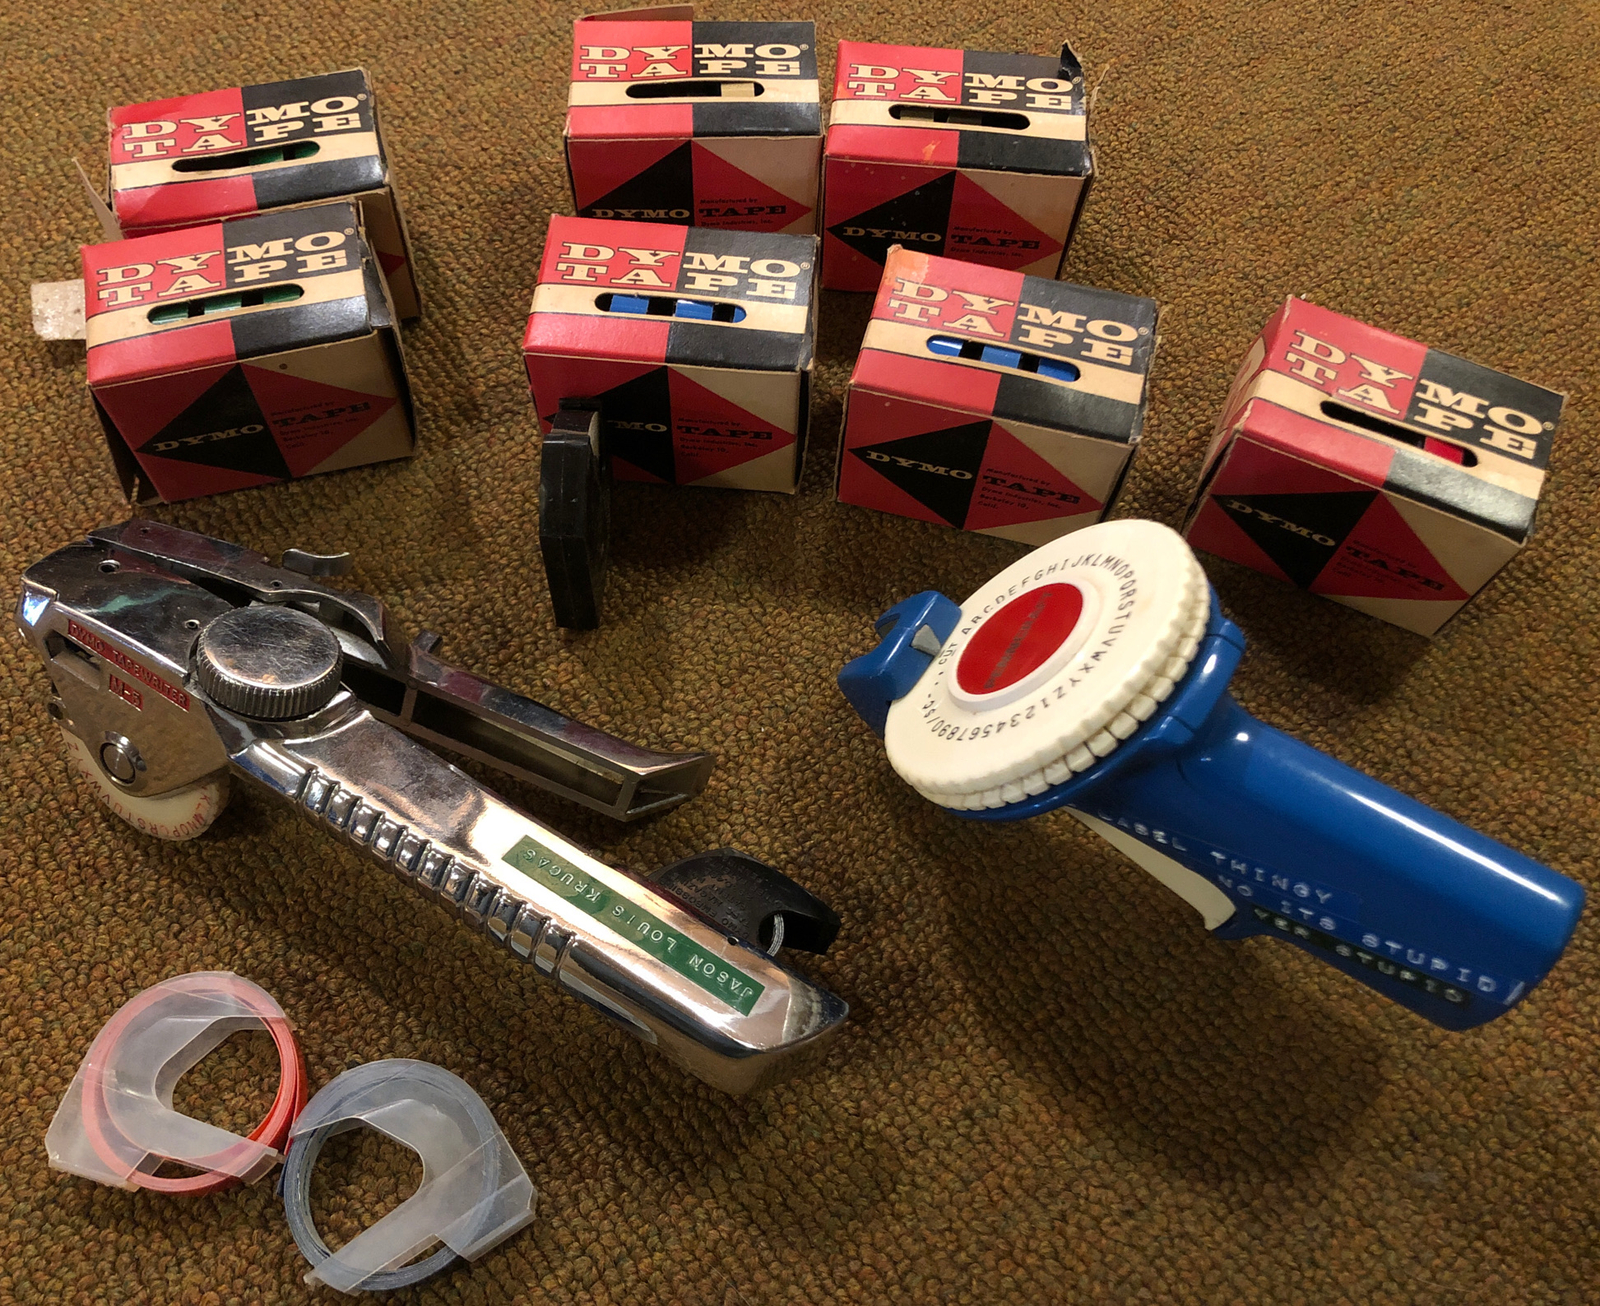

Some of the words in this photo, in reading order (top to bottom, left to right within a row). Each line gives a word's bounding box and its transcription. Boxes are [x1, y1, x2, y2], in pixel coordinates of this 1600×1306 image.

[579, 60, 800, 78] TAPE
[580, 44, 800, 61] DYMO
[848, 82, 1071, 110] TAPE
[850, 64, 1073, 92] DYMO
[122, 96, 359, 139] DYMO
[123, 113, 361, 157] TAPE
[592, 208, 690, 219] DYMO
[699, 205, 787, 217] TAPE
[97, 231, 346, 286] DYMO
[560, 241, 800, 278] DYMO
[843, 226, 941, 242] DYMO
[951, 234, 1040, 249] TAPE
[98, 250, 347, 307] TAPE
[555, 262, 797, 300] TAPE
[888, 299, 1133, 366] TAPE
[894, 278, 1138, 343] DYMO
[1284, 352, 1537, 460] TAPE
[1290, 330, 1543, 436] DYMO
[154, 424, 264, 451] DYMO
[272, 402, 370, 427] TAPE
[677, 424, 773, 440] TAPE
[866, 450, 973, 480] DYMO
[983, 475, 1080, 504] TAPE
[1228, 500, 1336, 547] DYMO
[1345, 546, 1444, 590] TAPE
[71, 623, 105, 653] DYMO
[112, 650, 188, 707] TAPEWRITER
[1210, 850, 1332, 904] THINGY
[611, 904, 677, 951] LOUIS
[1281, 900, 1337, 931] ITS
[1361, 933, 1497, 994] STUPID
[689, 954, 755, 999] JASON
